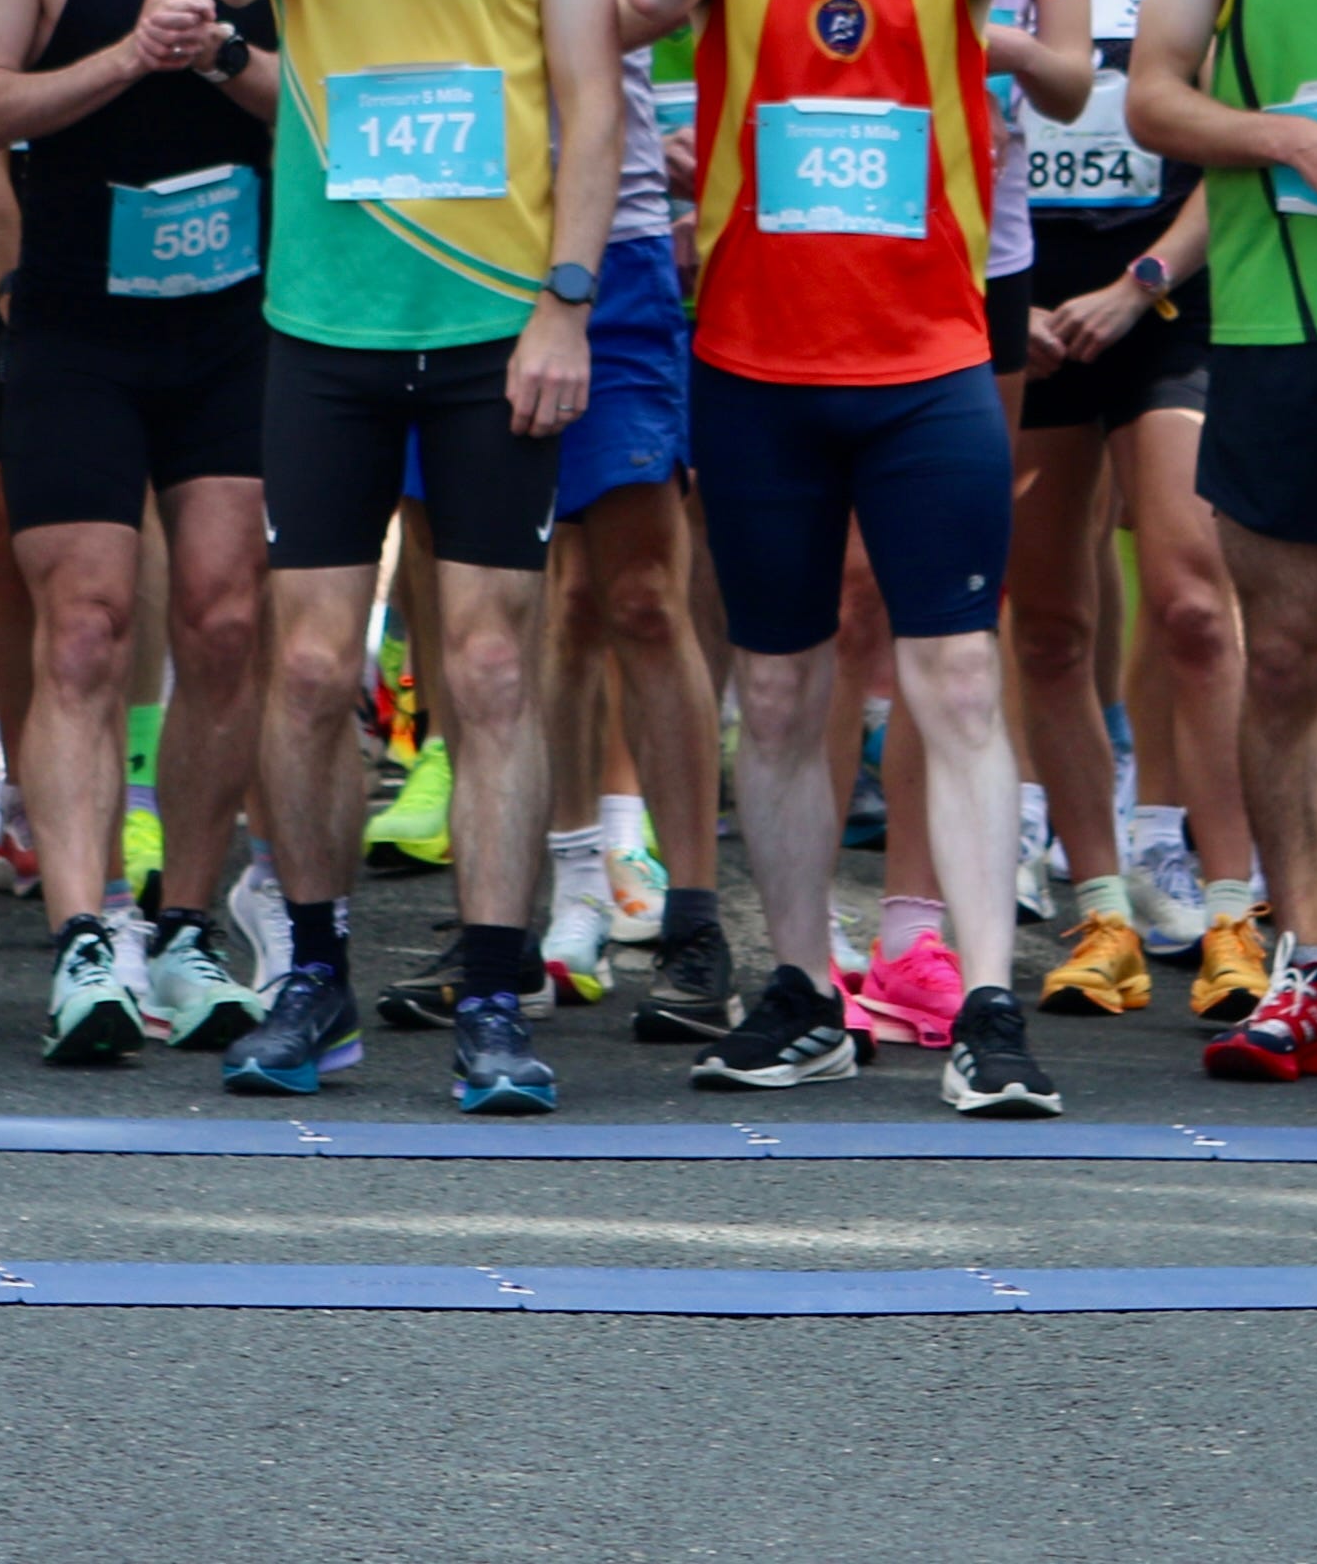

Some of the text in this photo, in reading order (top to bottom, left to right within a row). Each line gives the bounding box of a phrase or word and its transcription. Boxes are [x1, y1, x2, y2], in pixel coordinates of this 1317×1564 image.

[421, 89, 434, 105] 5
[435, 87, 474, 104] Mile
[358, 111, 476, 158] 1477
[849, 123, 861, 139] 5
[862, 123, 901, 141] Mile
[796, 146, 888, 190] 438
[1028, 150, 1133, 188] 8854
[151, 211, 232, 261] 586
